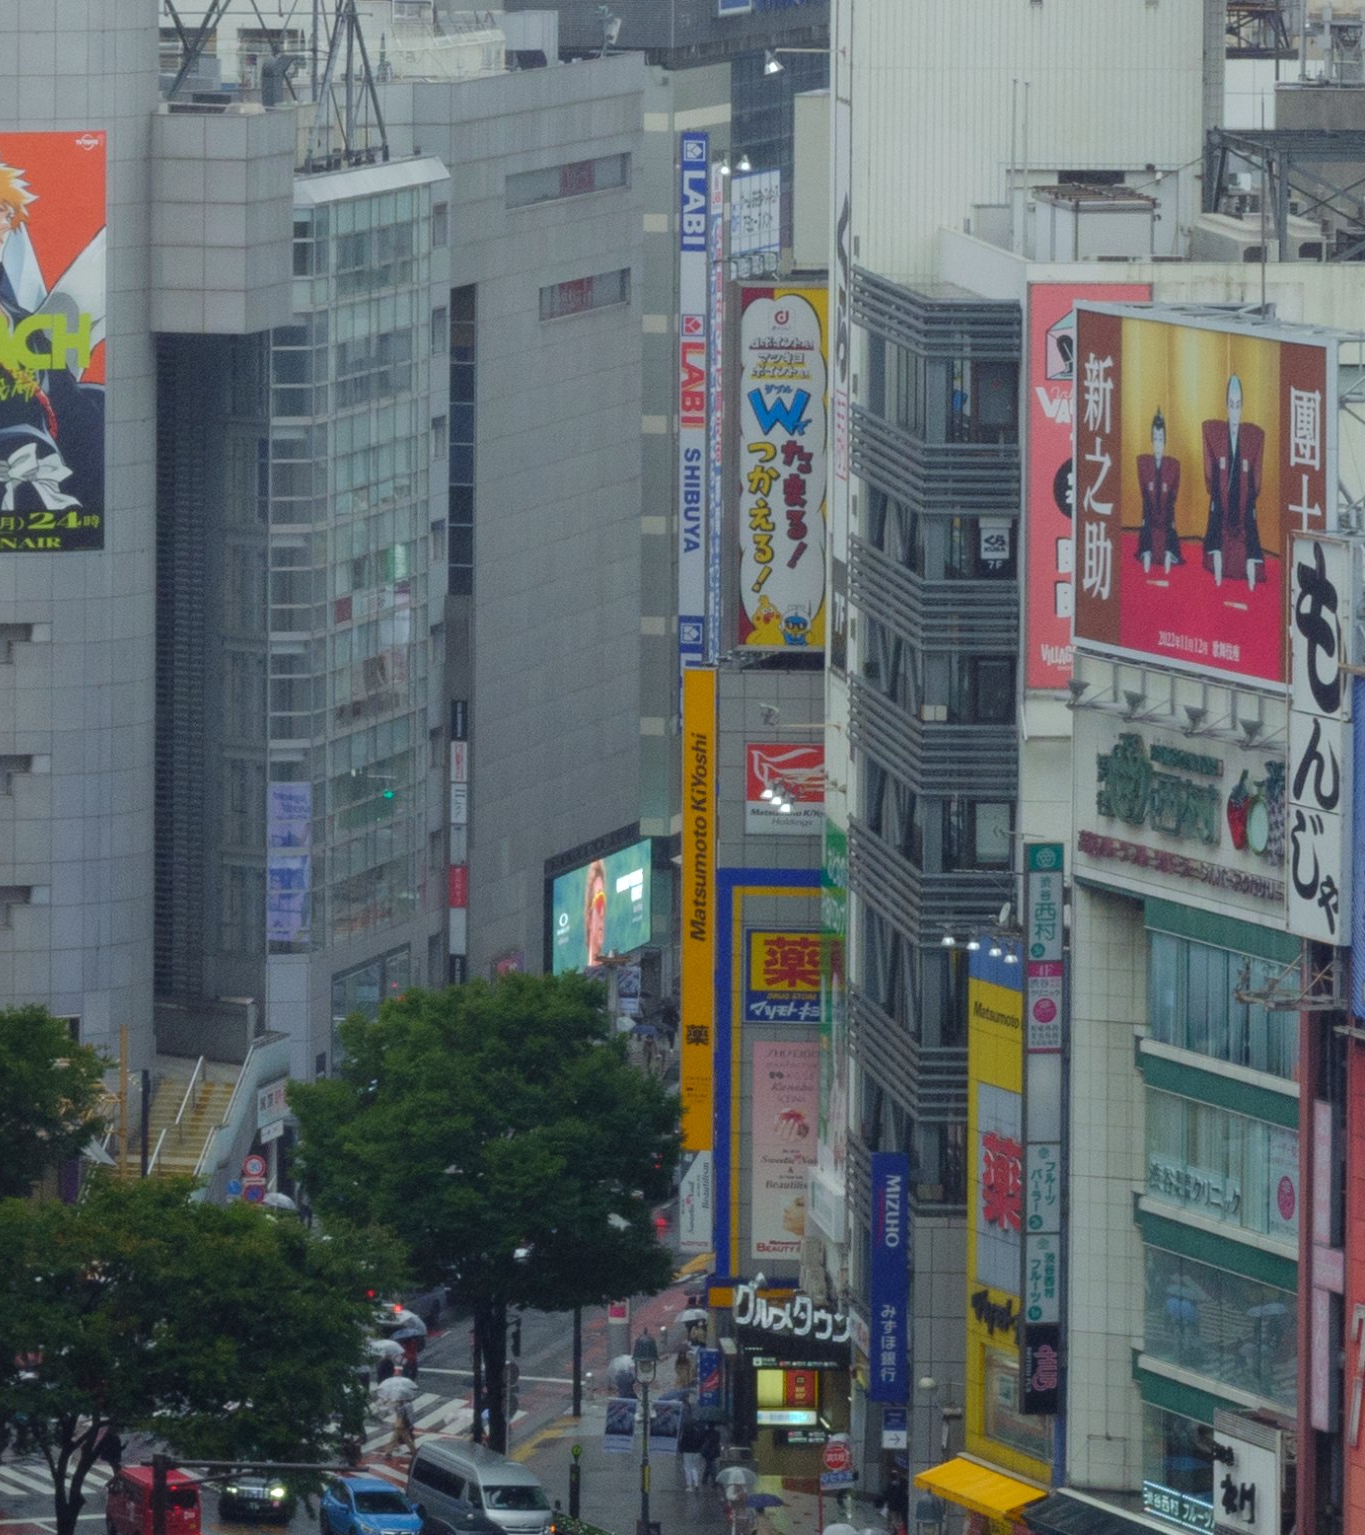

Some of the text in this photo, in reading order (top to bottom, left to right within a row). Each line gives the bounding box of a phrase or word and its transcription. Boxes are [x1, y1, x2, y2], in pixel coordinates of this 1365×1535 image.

[682, 170, 706, 250] LABI
[680, 341, 706, 430] LABI
[683, 446, 702, 554] SHIBUYA
[1083, 352, 1114, 601] 新之助
[689, 733, 707, 942] Matsumoto KiYoshi
[885, 1174, 901, 1248] MIZUHO
[1044, 1161, 1056, 1206] フルーツ
[734, 1271, 852, 1343] グルメタウン
[879, 1304, 898, 1383] みずほ銀行
